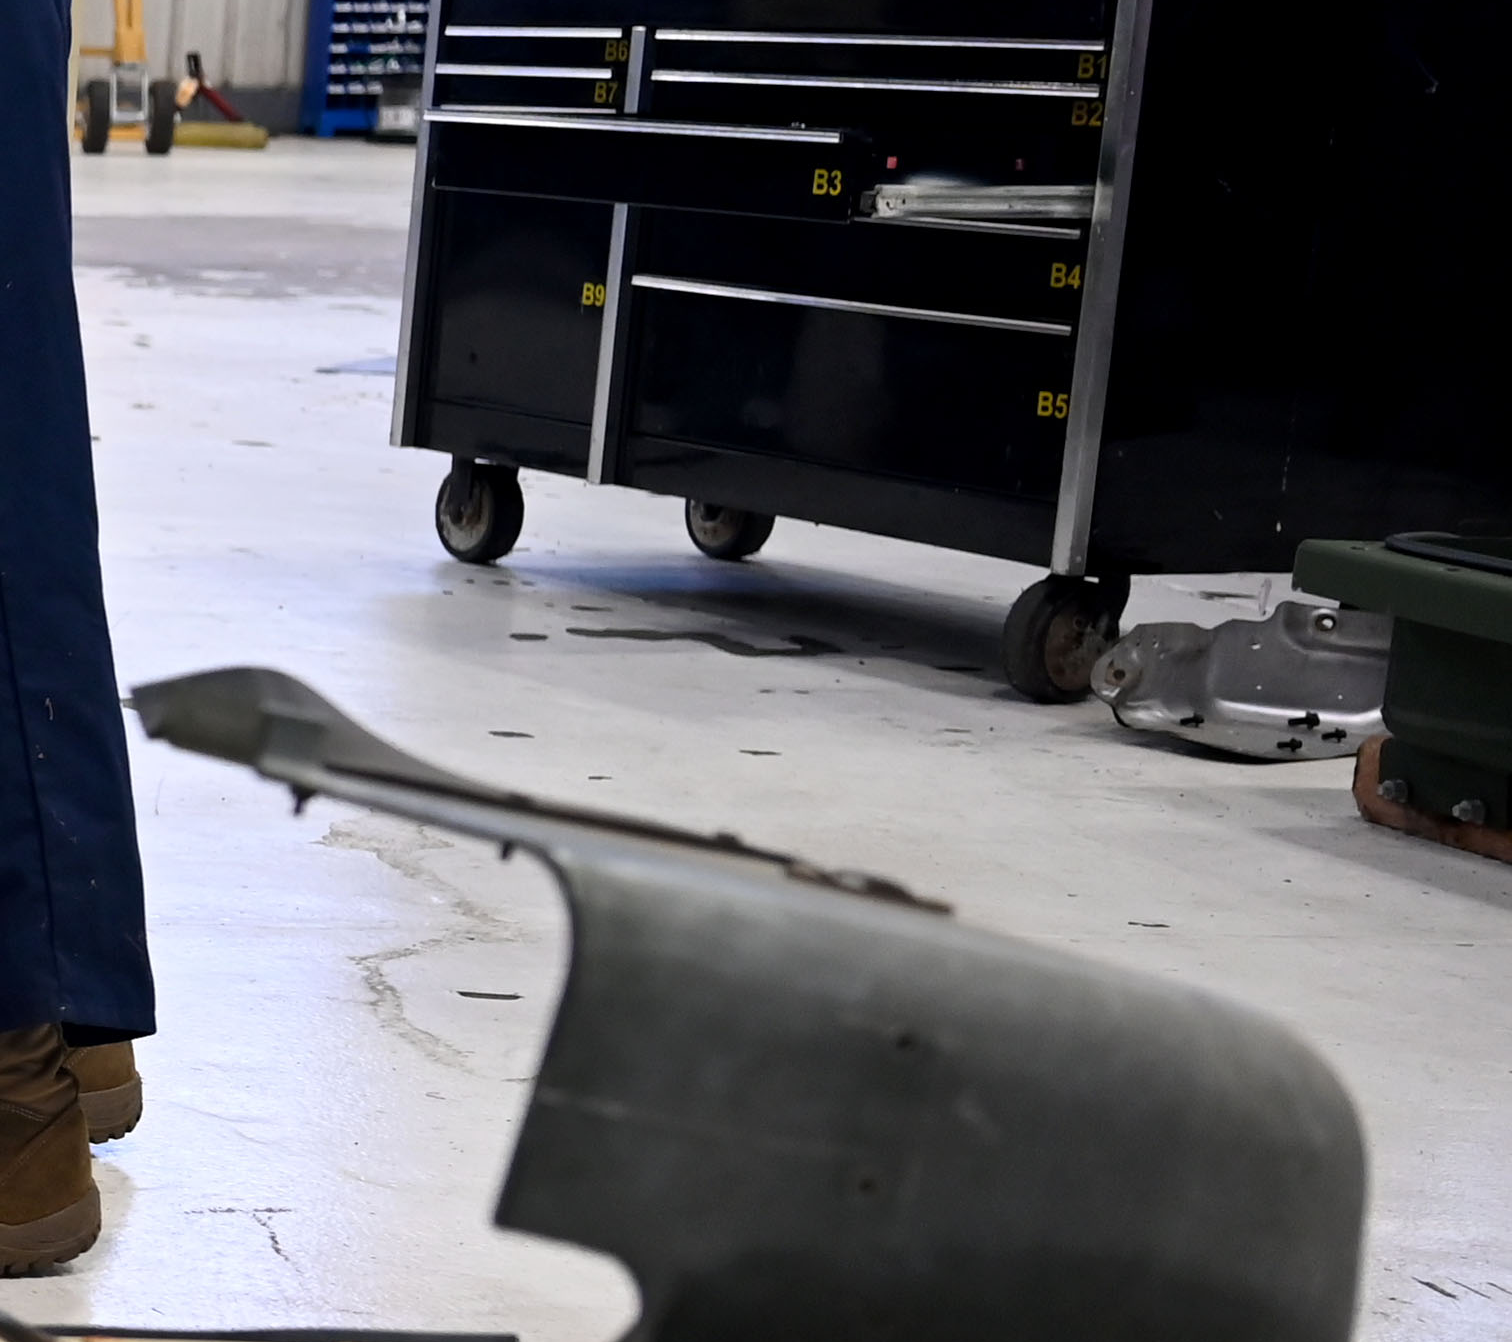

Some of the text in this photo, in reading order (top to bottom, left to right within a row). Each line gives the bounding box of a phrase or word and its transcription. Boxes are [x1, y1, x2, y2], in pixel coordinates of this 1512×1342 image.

[604, 40, 628, 62] B6
[1077, 54, 1107, 79] B1
[594, 82, 618, 104] B7
[1071, 102, 1102, 127] B2
[812, 169, 842, 196] B3
[1050, 263, 1081, 289] B4
[581, 283, 606, 307] B9
[1037, 391, 1069, 418] B5
